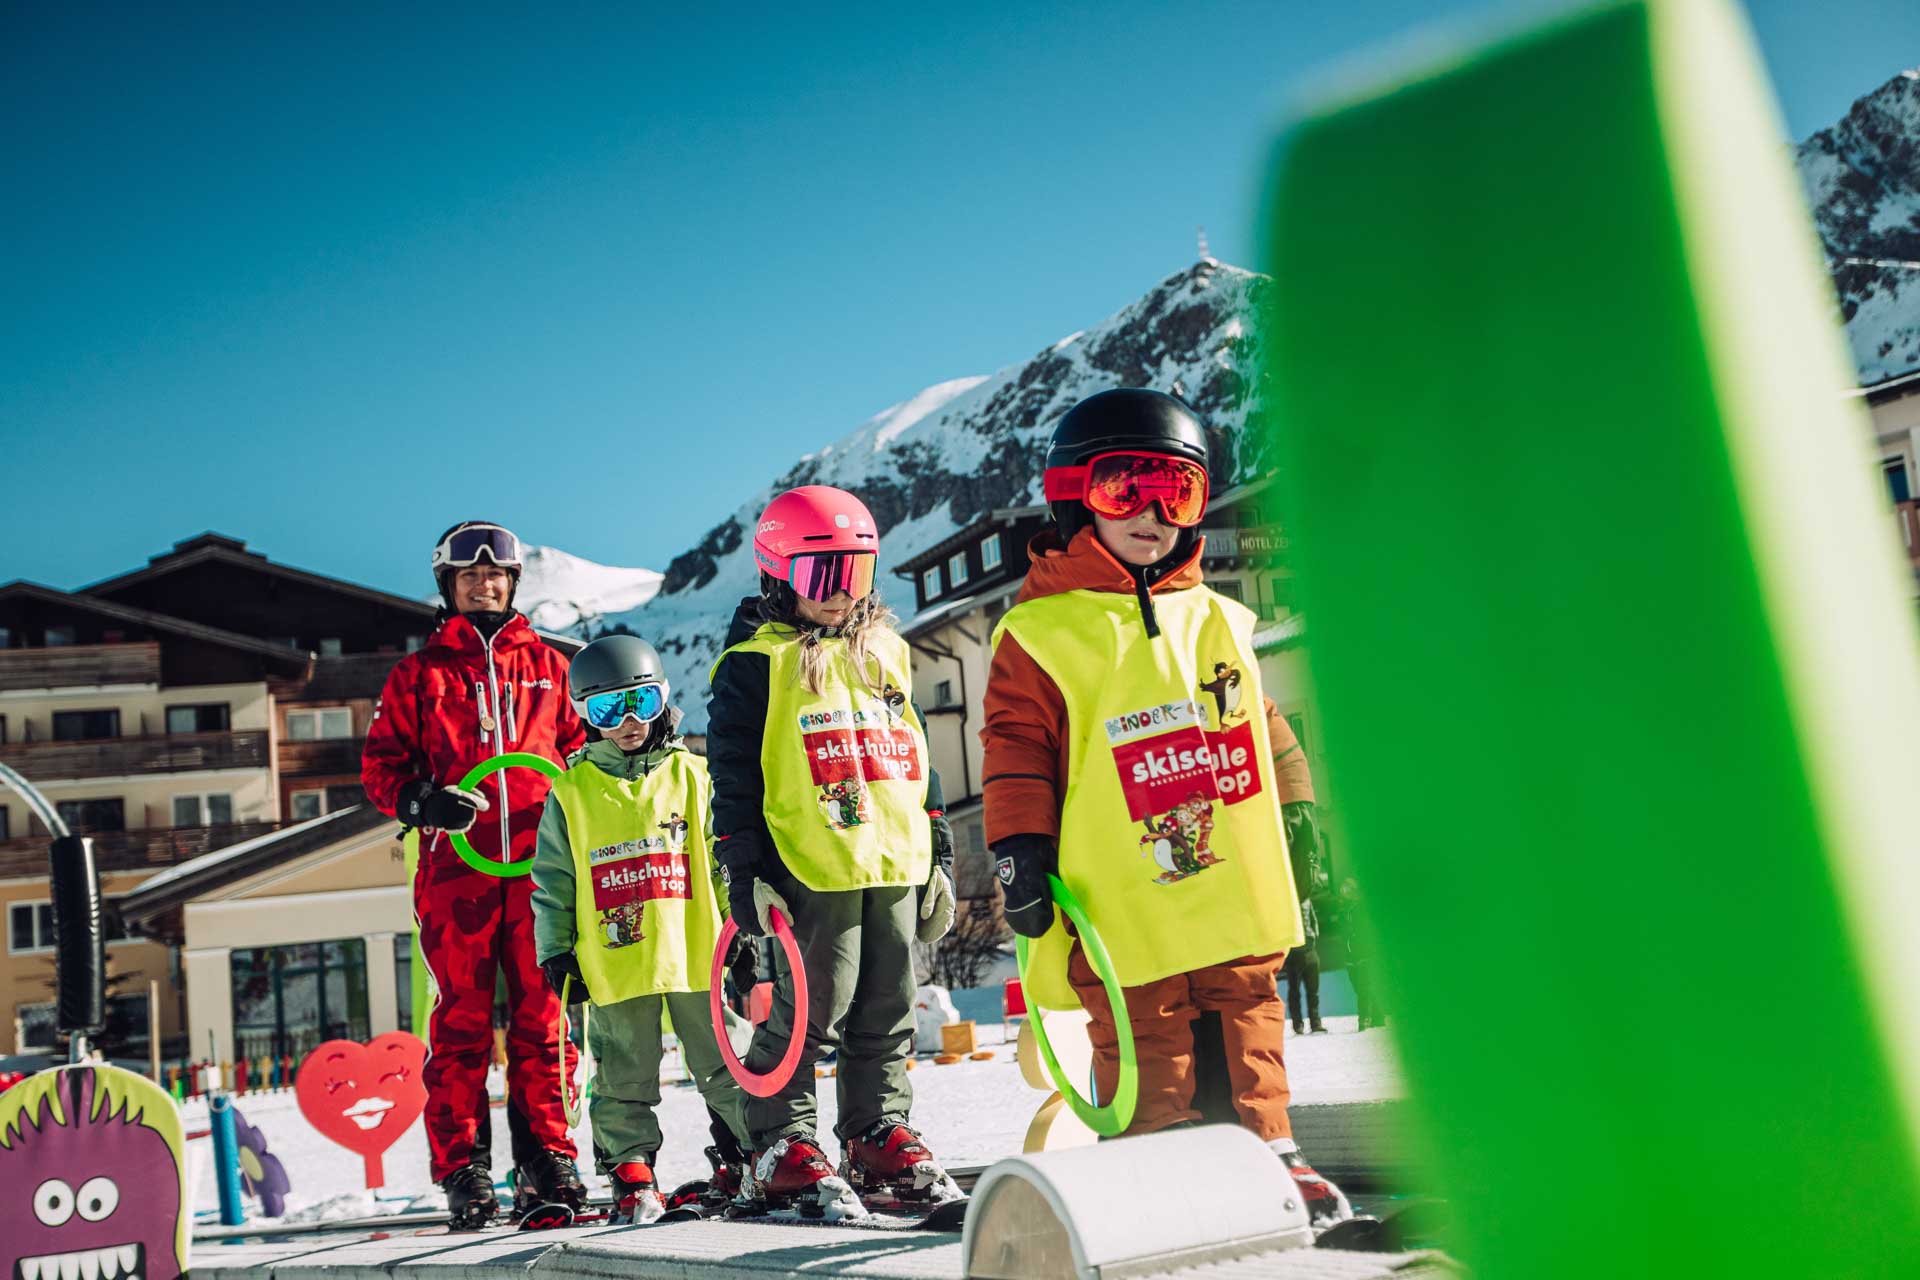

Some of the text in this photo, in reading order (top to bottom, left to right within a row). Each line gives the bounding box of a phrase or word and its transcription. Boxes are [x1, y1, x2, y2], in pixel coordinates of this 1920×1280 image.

[1241, 536, 1272, 551] HOTEL
[1132, 742, 1248, 783] skiscle
[1217, 769, 1252, 796] op
[601, 860, 686, 889] skischule
[660, 878, 686, 894] top
